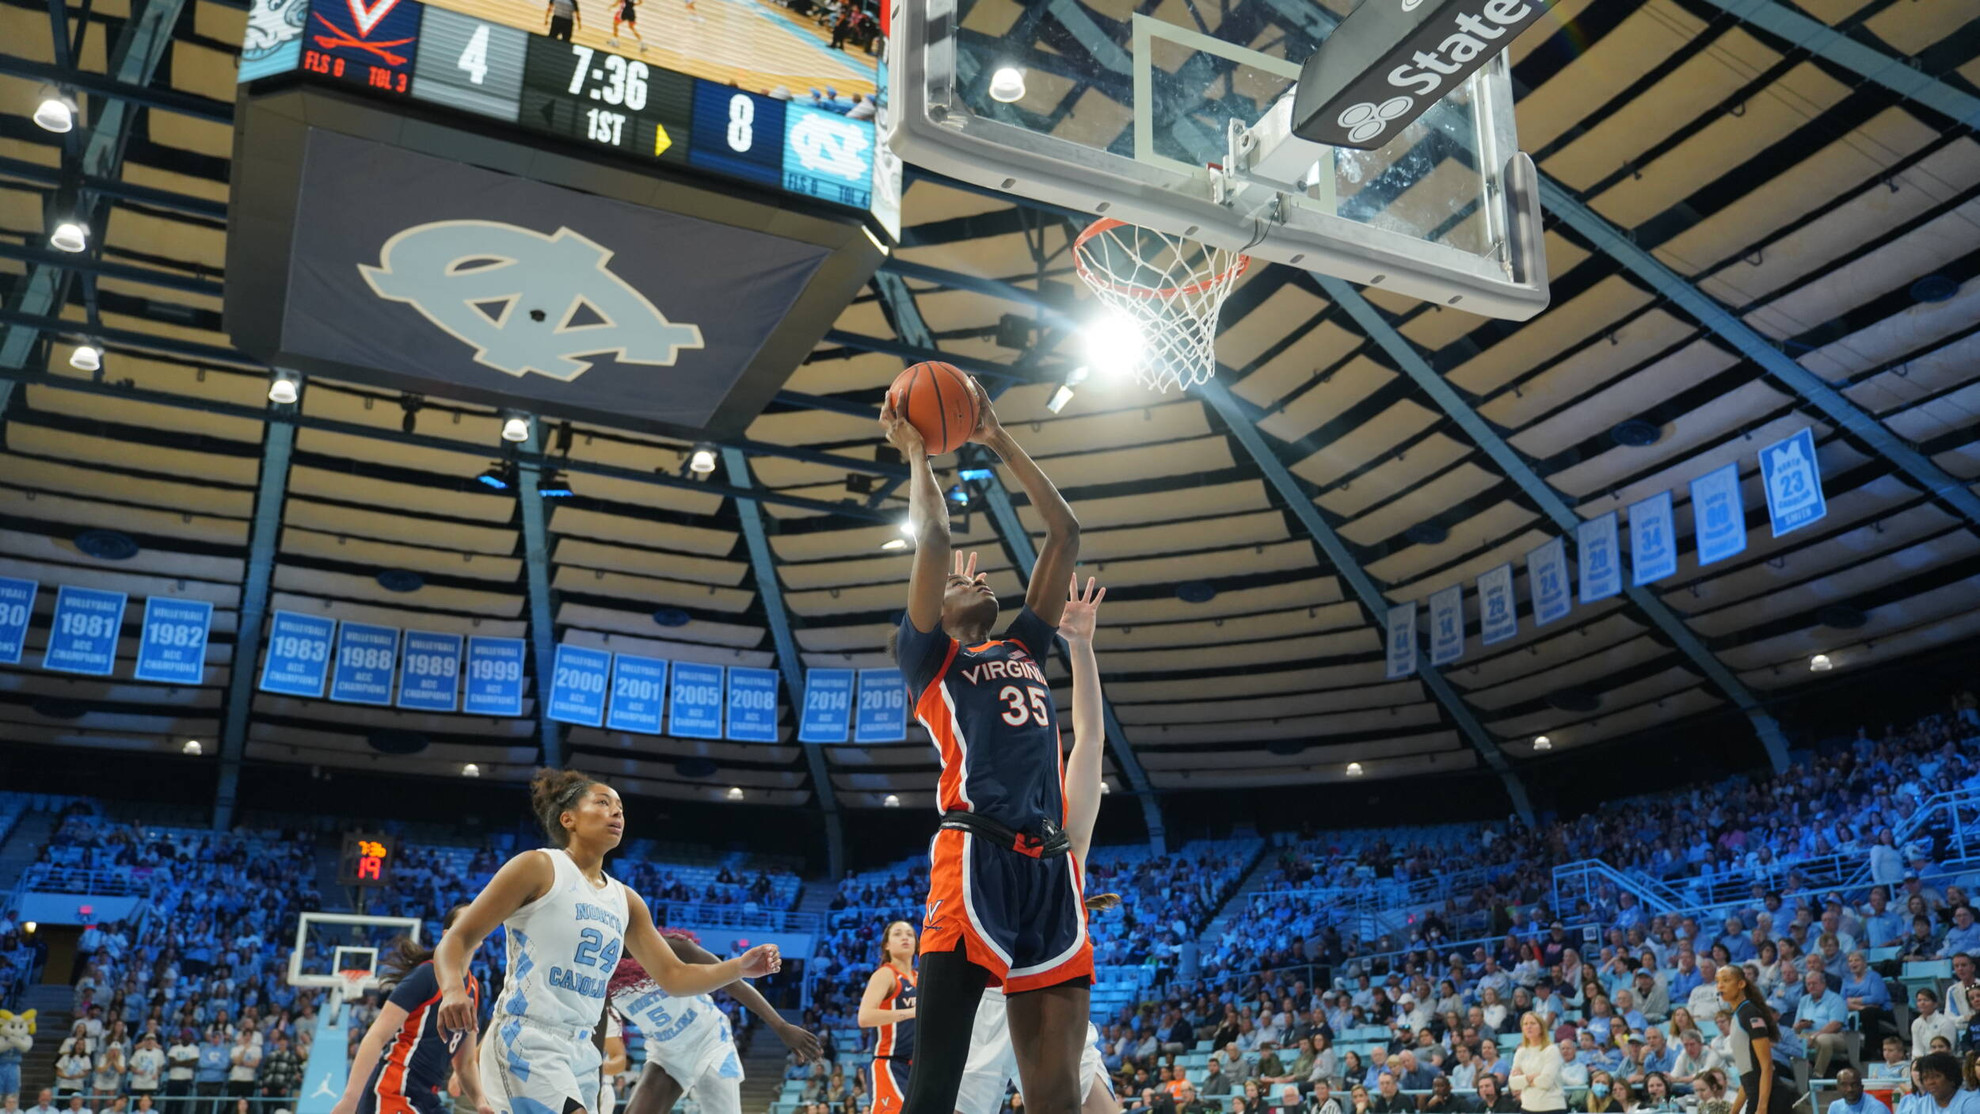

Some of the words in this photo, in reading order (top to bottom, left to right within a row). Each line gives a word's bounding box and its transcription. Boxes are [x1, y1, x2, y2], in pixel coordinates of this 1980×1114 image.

[457, 24, 490, 85] 4
[1387, 0, 1532, 95] State
[304, 50, 331, 74] FLS
[368, 66, 392, 90] TOL
[396, 73, 407, 93] 3
[568, 44, 649, 111] 7:36
[586, 108, 626, 146] 1ST
[727, 93, 755, 153] 8
[1780, 470, 1804, 498] 23
[61, 612, 115, 639] 1981
[149, 623, 203, 648] 1982
[274, 636, 327, 662] 1983
[342, 647, 392, 671] 1988
[407, 654, 456, 677] 1989
[471, 659, 519, 681] 1999
[557, 667, 604, 693] 2000
[617, 677, 659, 701] 2001
[675, 684, 719, 706] 2005
[731, 689, 775, 710] 2008
[808, 691, 846, 710] 2014
[862, 690, 903, 710] 2016
[1000, 685, 1049, 727] 35
[574, 927, 620, 973] 24
[646, 1006, 672, 1027] 5
